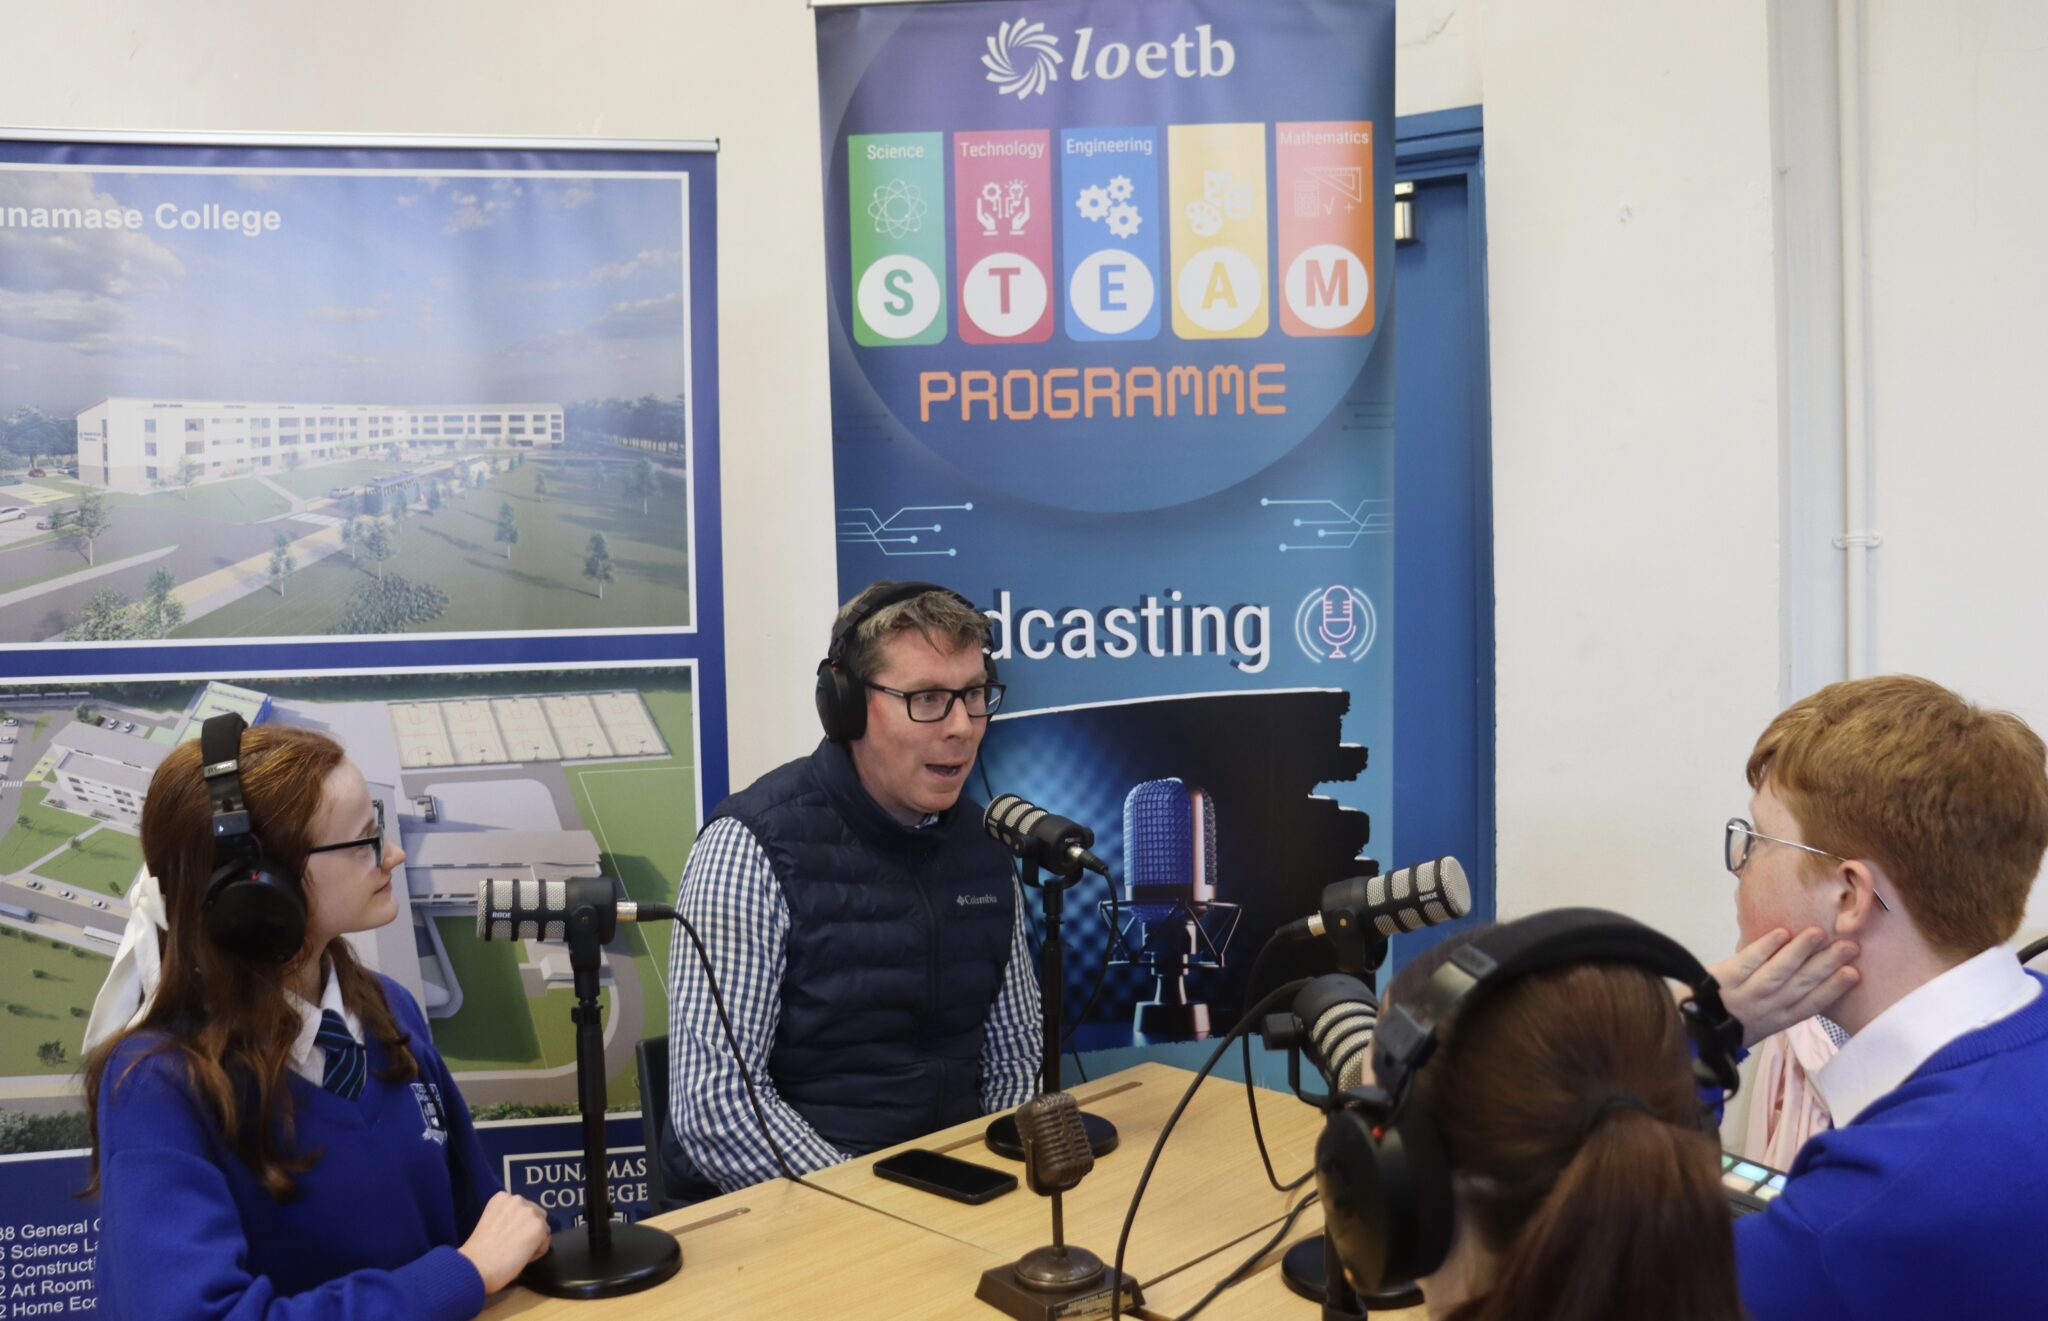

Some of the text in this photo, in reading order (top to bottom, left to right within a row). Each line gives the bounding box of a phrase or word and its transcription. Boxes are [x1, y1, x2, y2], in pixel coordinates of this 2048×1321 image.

[1071, 24, 1235, 81] loetb
[1066, 137, 1153, 157] Engineering
[1280, 130, 1369, 145] Mathematics
[867, 145, 925, 160] Science
[960, 141, 1046, 160] Technology
[155, 203, 281, 237] College
[919, 363, 1286, 422] PROGRAMME
[525, 1158, 648, 1185] DUNMAS
[540, 1182, 649, 1209] COEGE
[21, 1219, 88, 1239] General
[11, 1242, 79, 1259] Science
[10, 1282, 36, 1298] Art
[13, 1300, 64, 1318] Home
